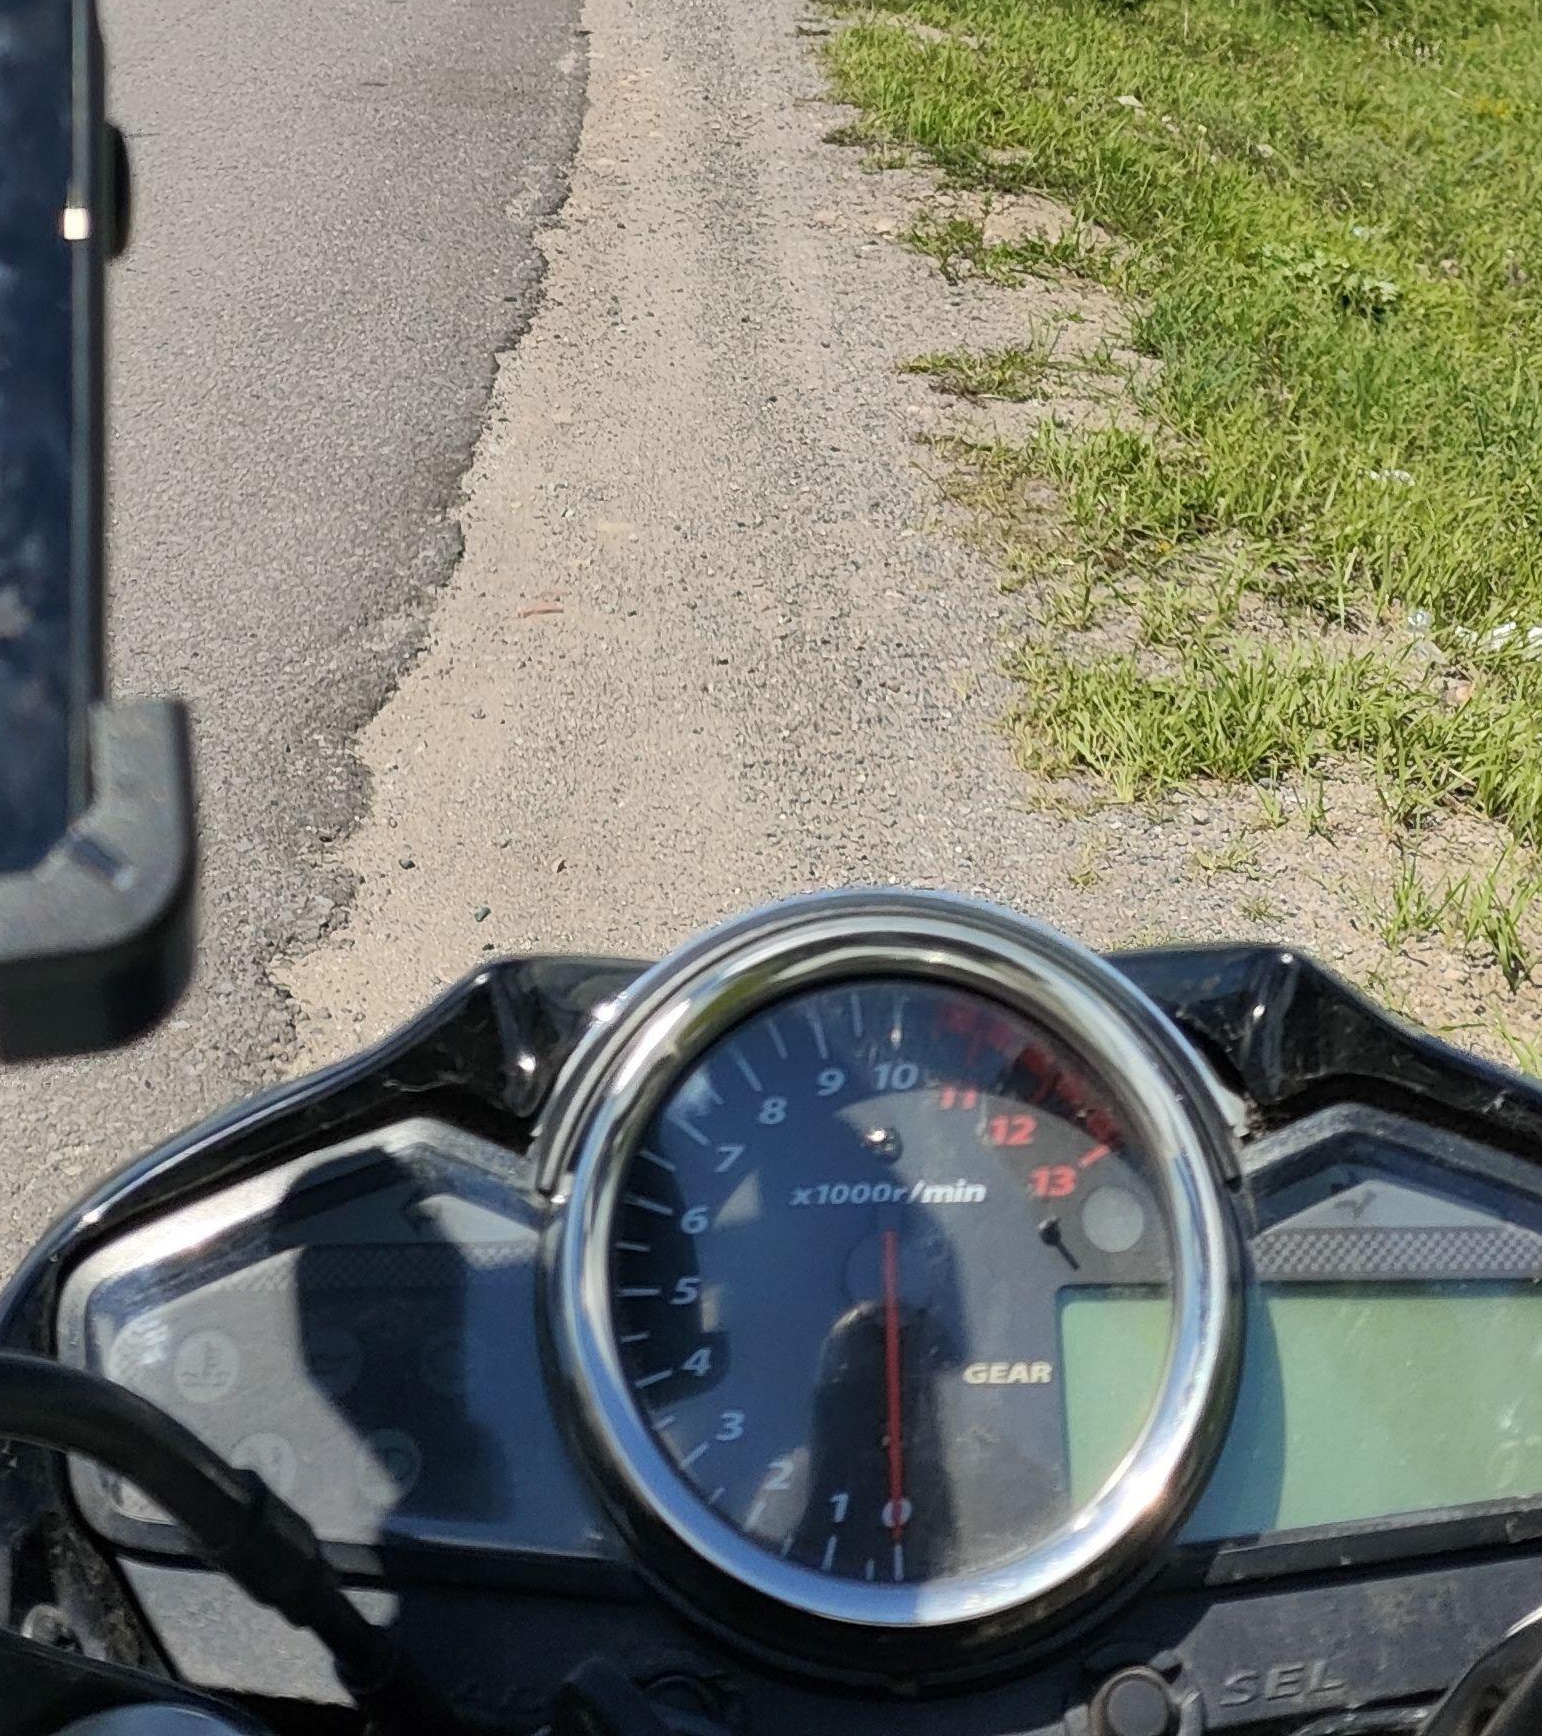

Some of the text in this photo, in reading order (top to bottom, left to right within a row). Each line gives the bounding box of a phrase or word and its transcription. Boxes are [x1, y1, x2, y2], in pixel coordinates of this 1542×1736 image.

[818, 1069, 845, 1095] 9
[873, 1064, 919, 1090] 10
[759, 1098, 786, 1125] 8
[937, 1088, 978, 1110] 11
[987, 1116, 1037, 1145] 12
[718, 1145, 745, 1173] 7
[790, 1180, 987, 1206] x1000r/min
[1030, 1167, 1077, 1196] 13
[681, 1206, 708, 1233] 6
[671, 1278, 700, 1305] 5
[683, 1349, 712, 1376] 4
[963, 1362, 1054, 1385] GEAR
[716, 1413, 745, 1440] 3
[765, 1463, 793, 1490] 2
[830, 1494, 847, 1521] 1
[1219, 1661, 1347, 1707] SEL
